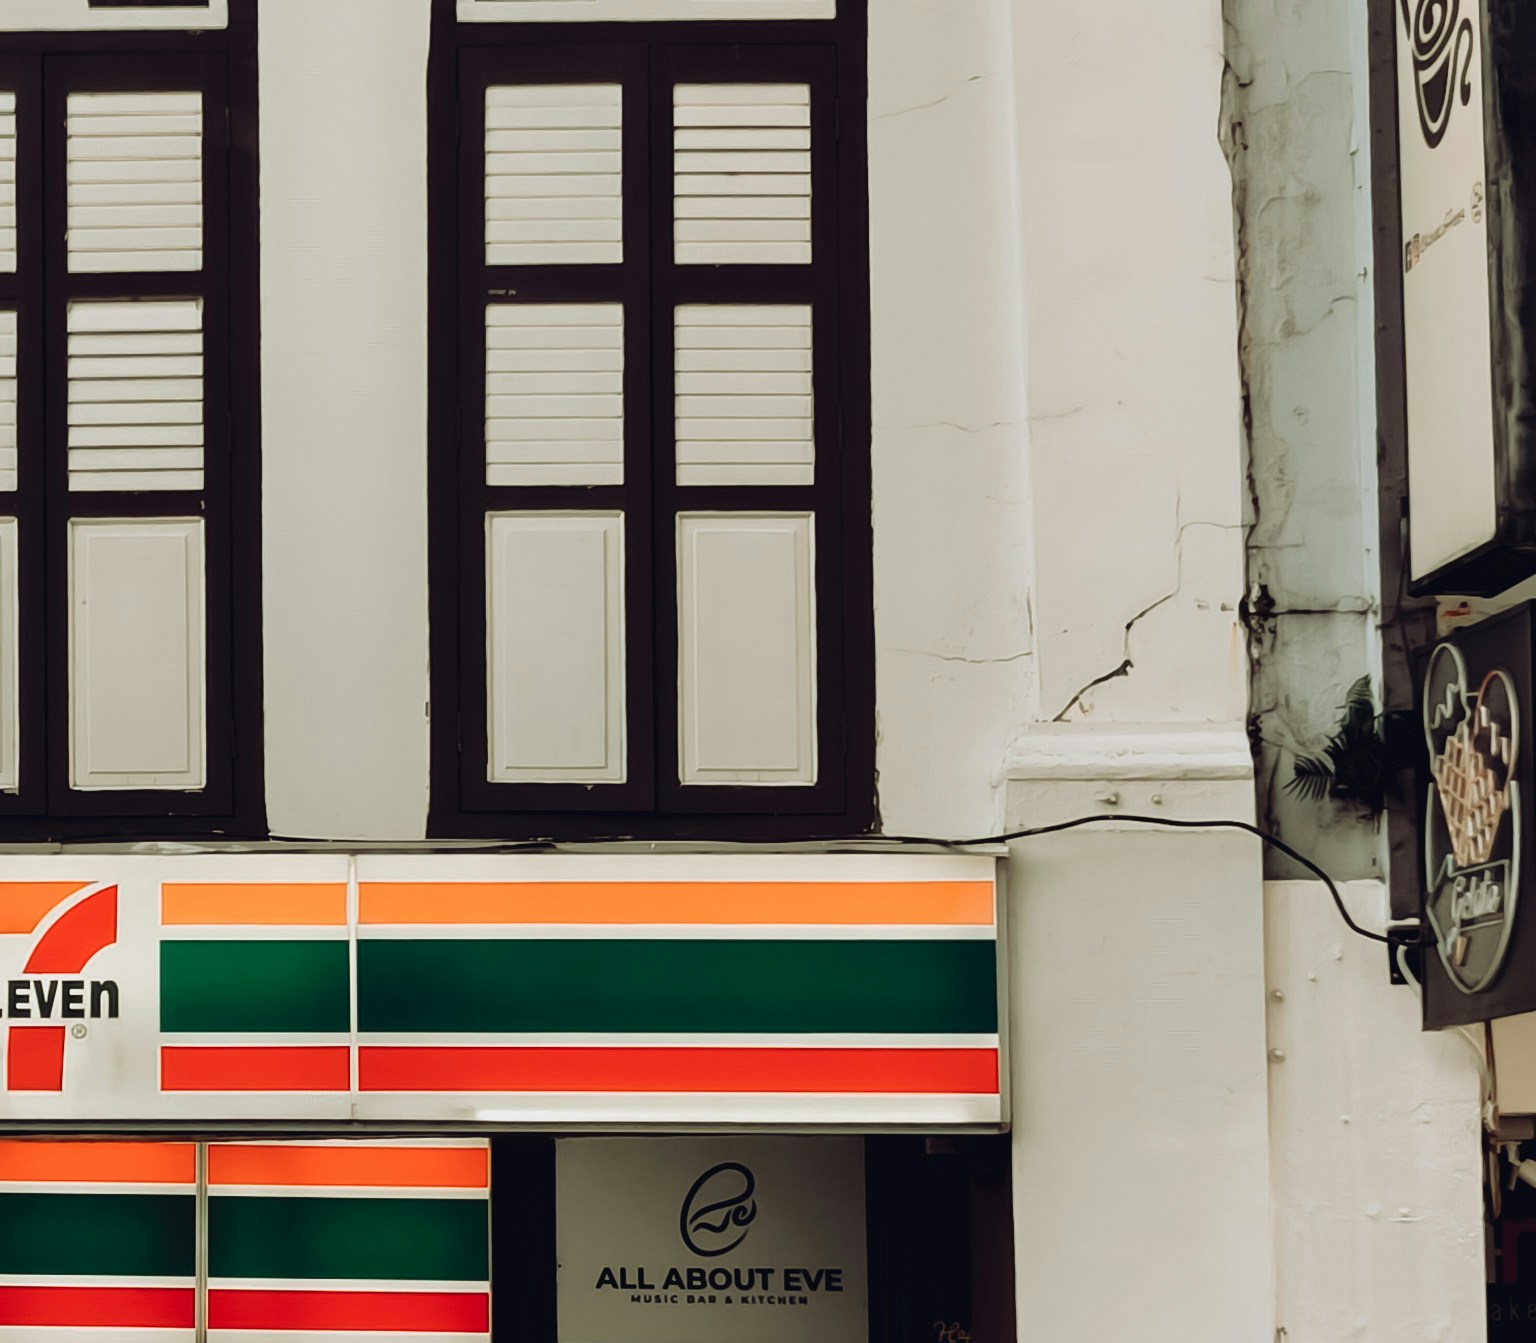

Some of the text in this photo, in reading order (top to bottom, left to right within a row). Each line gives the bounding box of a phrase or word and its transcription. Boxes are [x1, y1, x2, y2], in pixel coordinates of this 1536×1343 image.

[595, 1267, 843, 1292] ALL ABOUT EVE
[631, 1294, 808, 1305] MUSIC BAR & KITCHEN
